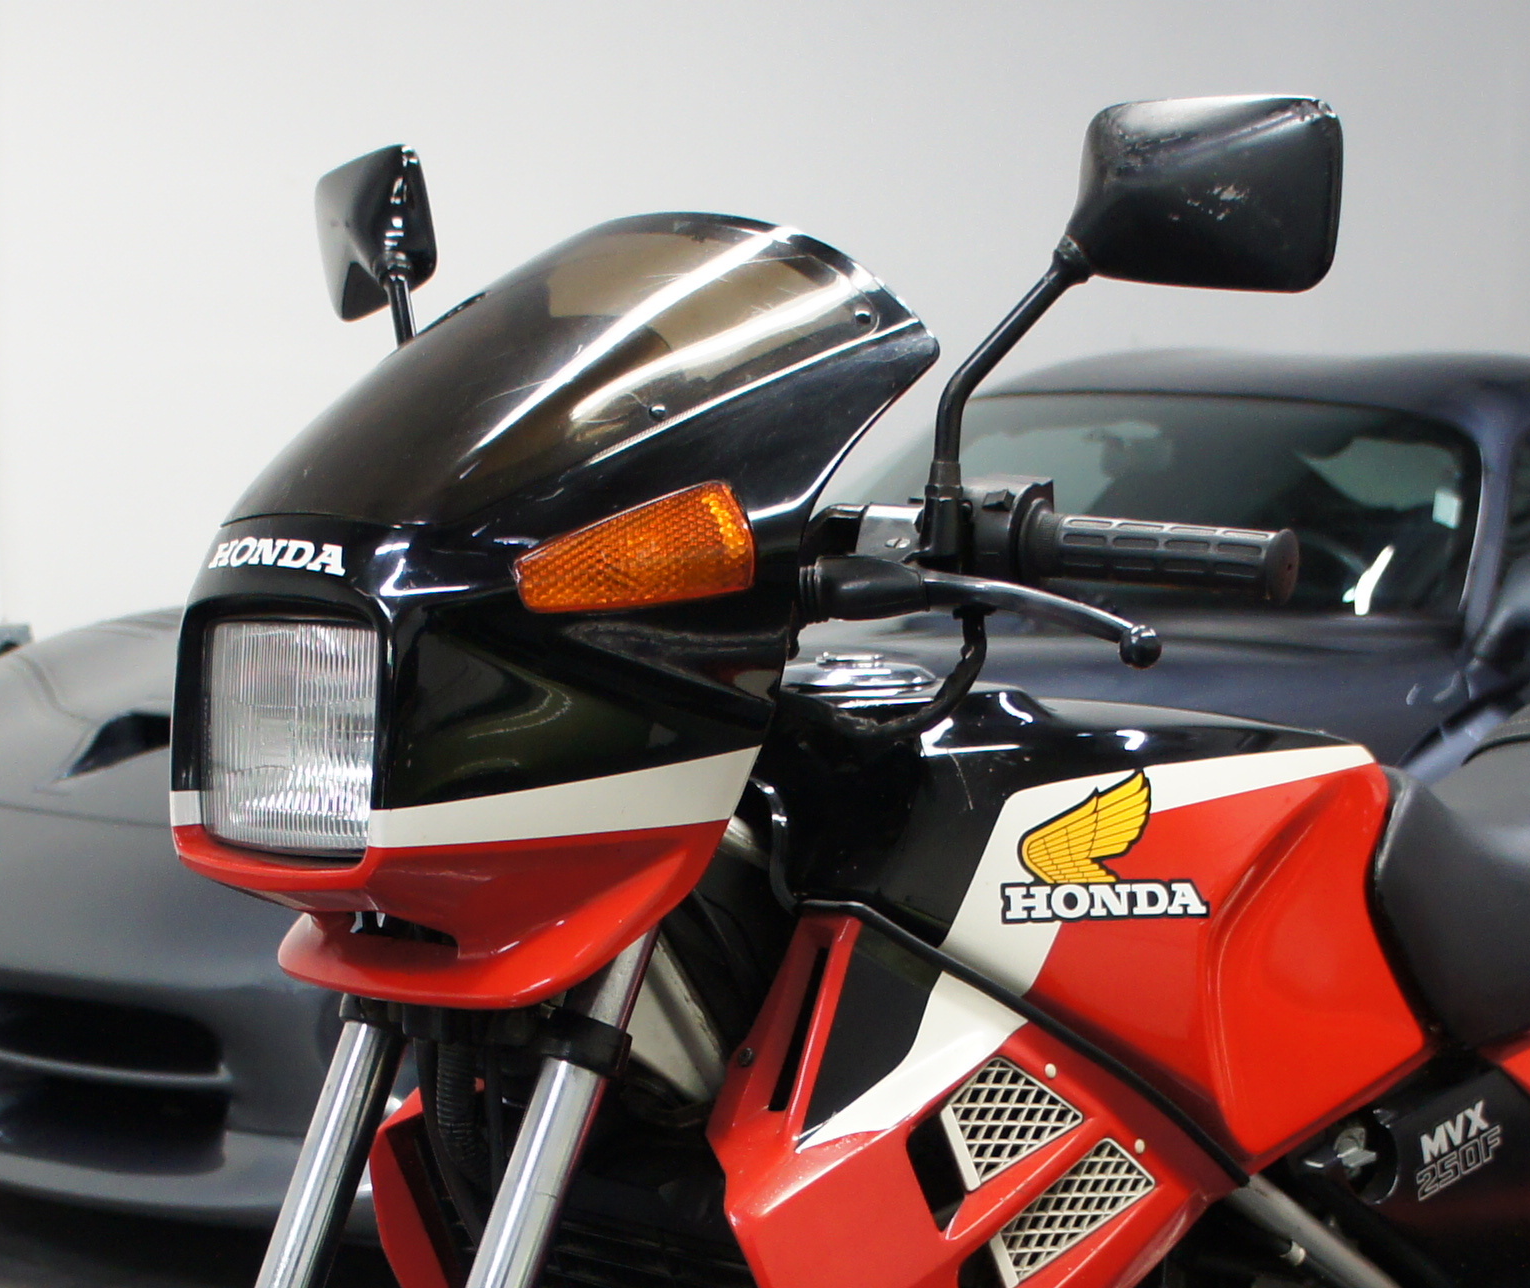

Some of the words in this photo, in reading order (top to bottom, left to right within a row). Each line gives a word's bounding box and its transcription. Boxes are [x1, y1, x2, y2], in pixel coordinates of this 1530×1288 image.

[208, 536, 346, 577] HONDA
[1003, 882, 1208, 921] HONDA
[1419, 1100, 1490, 1164] MVX
[1415, 1124, 1503, 1201] 250F
